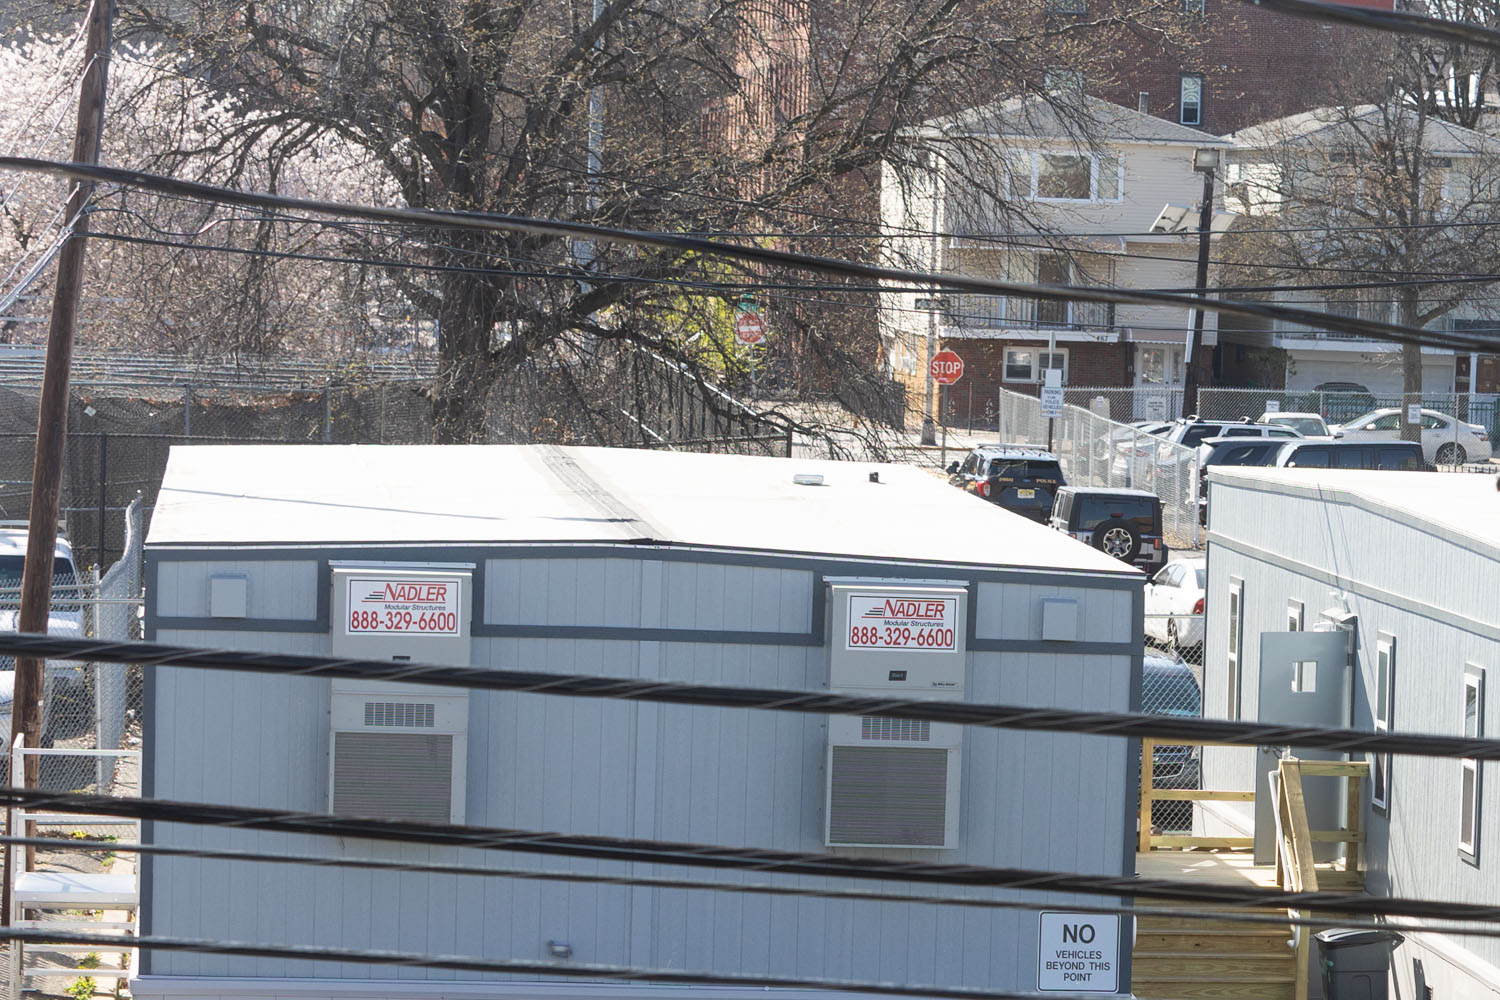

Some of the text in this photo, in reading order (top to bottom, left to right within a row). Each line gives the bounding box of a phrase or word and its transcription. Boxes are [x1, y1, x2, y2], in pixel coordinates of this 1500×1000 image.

[932, 361, 961, 375] STOP
[383, 583, 447, 602] NADLER
[882, 599, 945, 618] NADLER
[351, 612, 456, 632] 888-329-6600
[910, 620, 944, 628] Structures
[851, 627, 953, 648] 888-329-6600
[1062, 923, 1096, 943] NO
[1055, 950, 1102, 960] VEHICLES
[1045, 961, 1111, 971] BEYOND THIS
[1063, 972, 1092, 982] POINT
